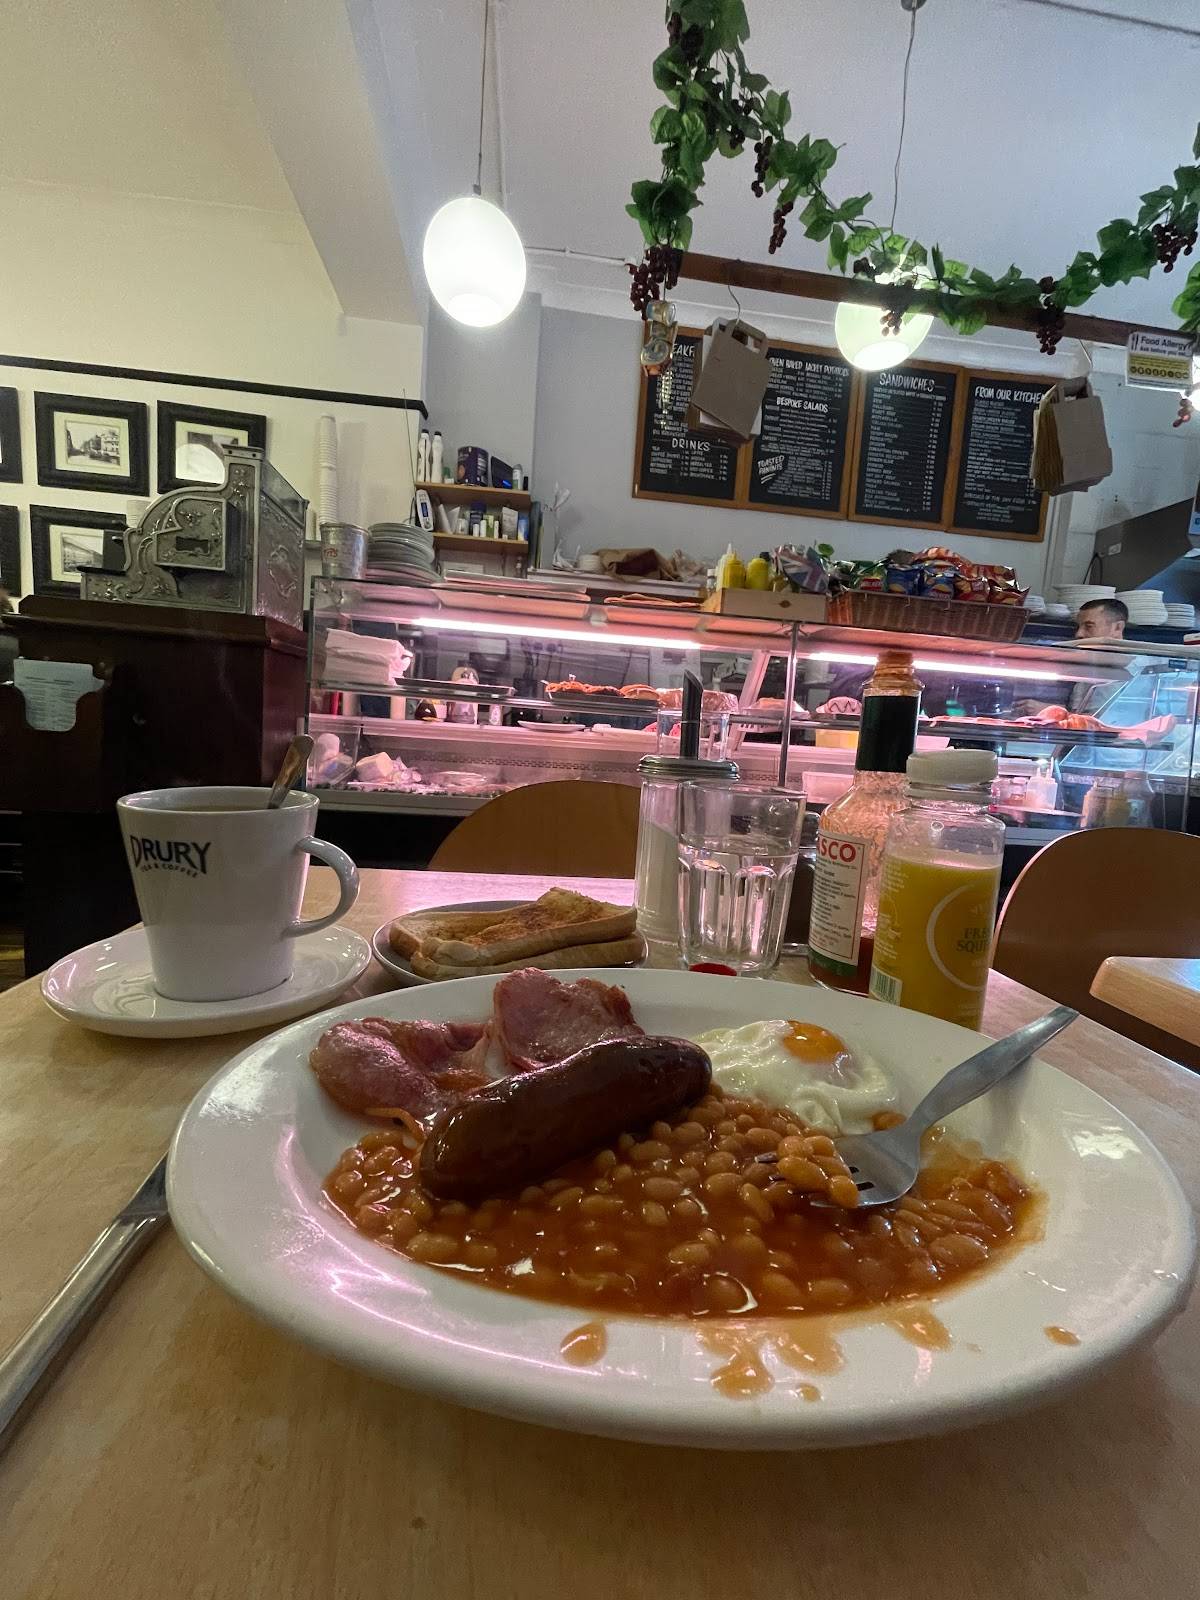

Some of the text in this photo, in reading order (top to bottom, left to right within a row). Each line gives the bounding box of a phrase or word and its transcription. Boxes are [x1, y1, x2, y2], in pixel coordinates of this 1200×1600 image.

[1141, 336, 1160, 346] Food
[879, 372, 935, 392] SANDWICHES
[975, 385, 995, 399] FROM
[996, 388, 1012, 401] OUR
[776, 396, 829, 413] BESPOKE SALADS
[671, 437, 711, 451] DRINKS
[757, 455, 785, 468] TOASTED
[129, 834, 212, 875] DRURY
